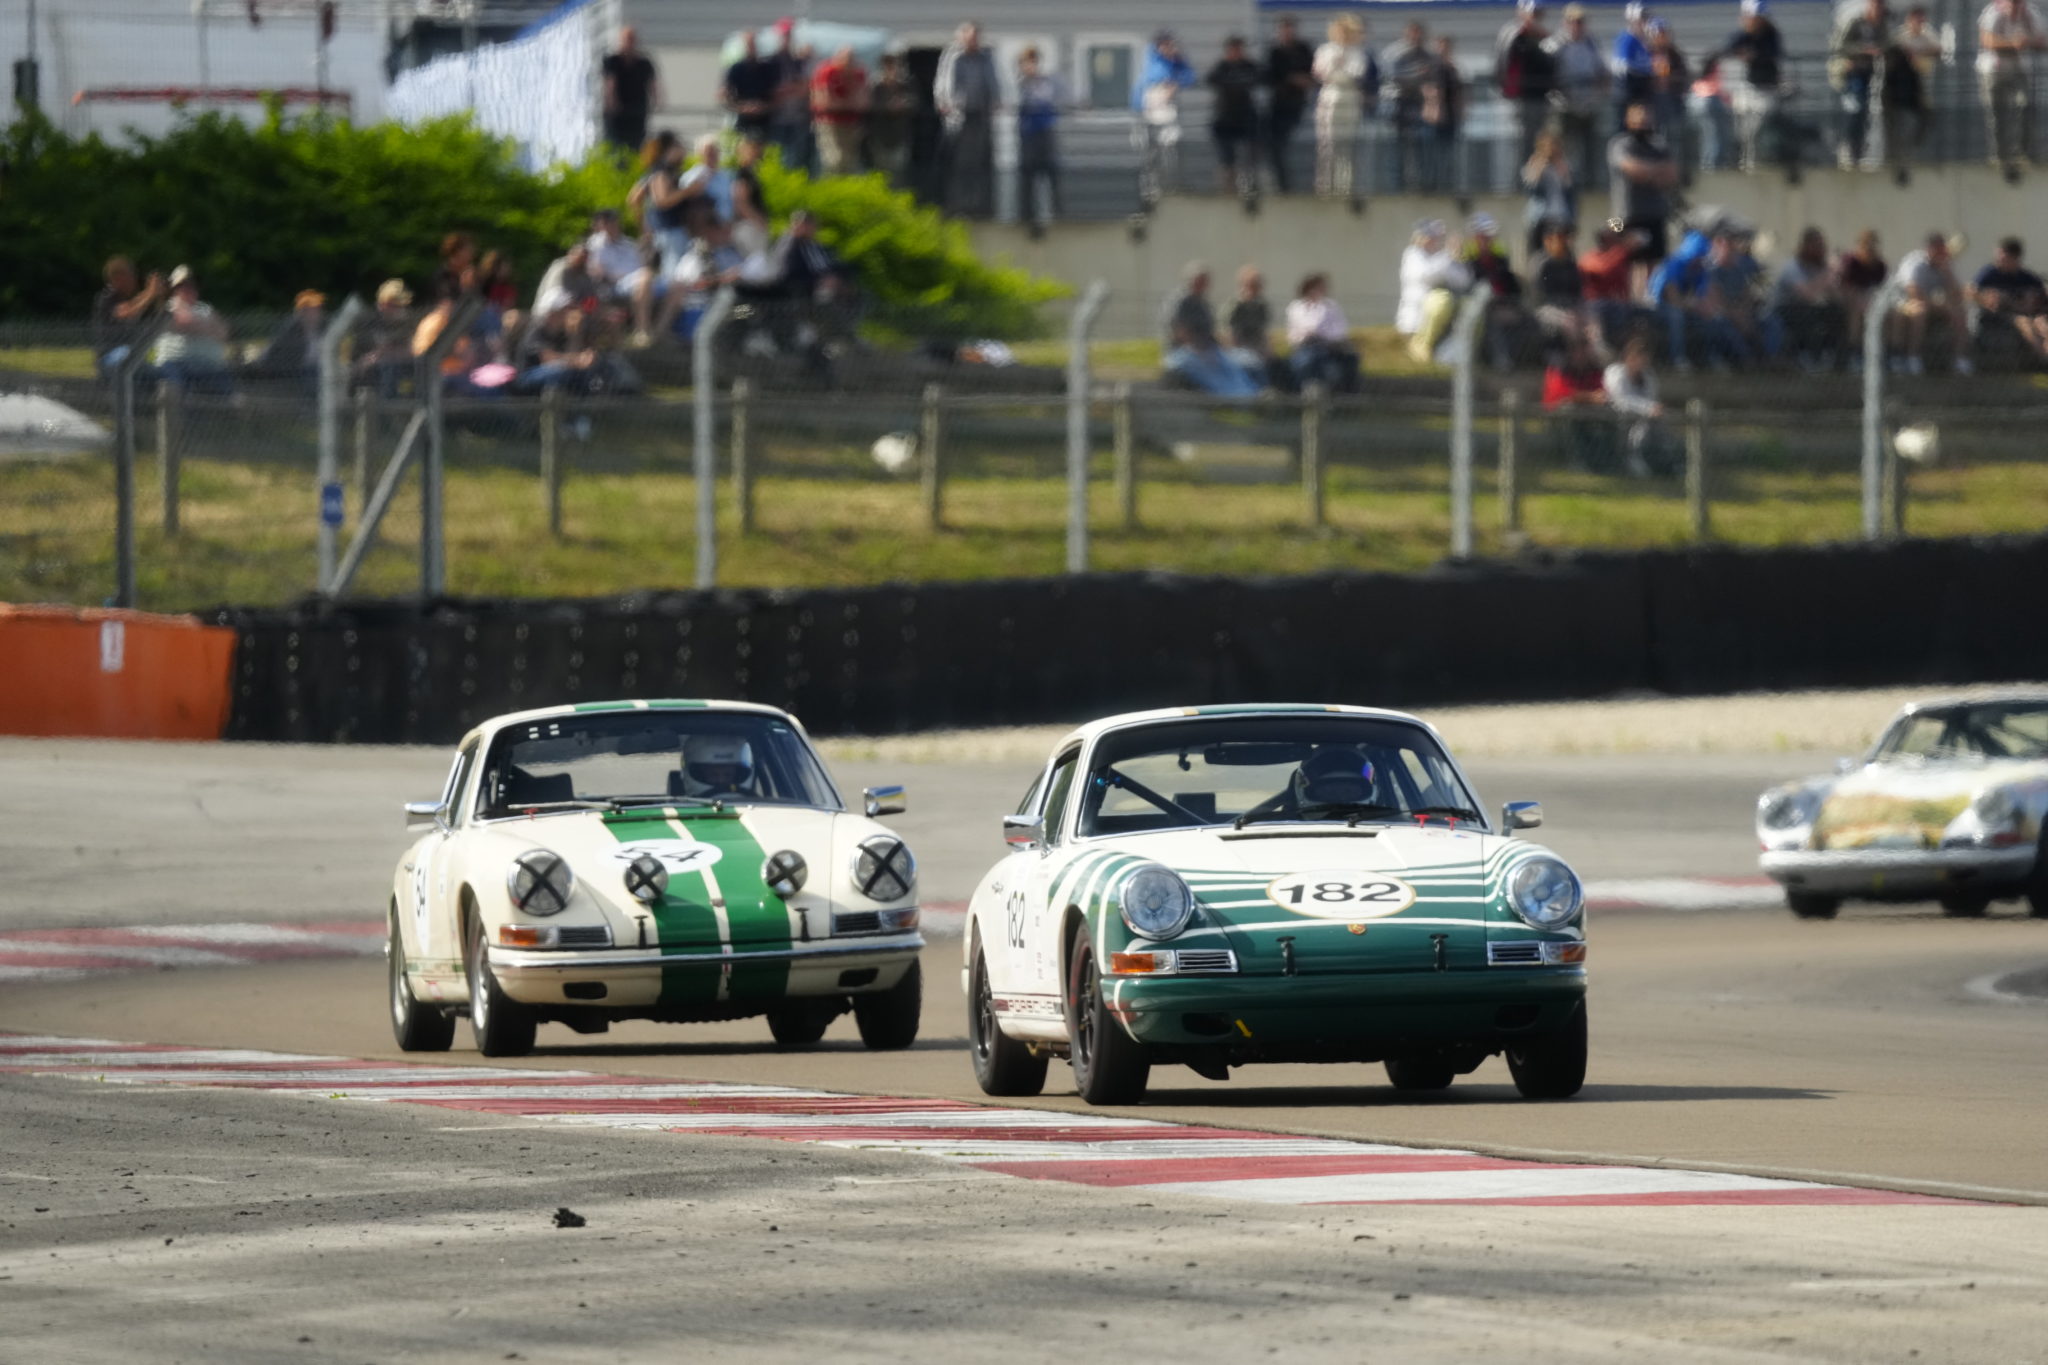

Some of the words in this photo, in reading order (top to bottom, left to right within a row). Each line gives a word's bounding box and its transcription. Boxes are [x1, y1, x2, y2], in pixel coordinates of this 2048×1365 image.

[614, 846, 703, 862] 54
[416, 867, 426, 917] 54
[1279, 882, 1400, 903] 182
[1007, 890, 1025, 948] 182
